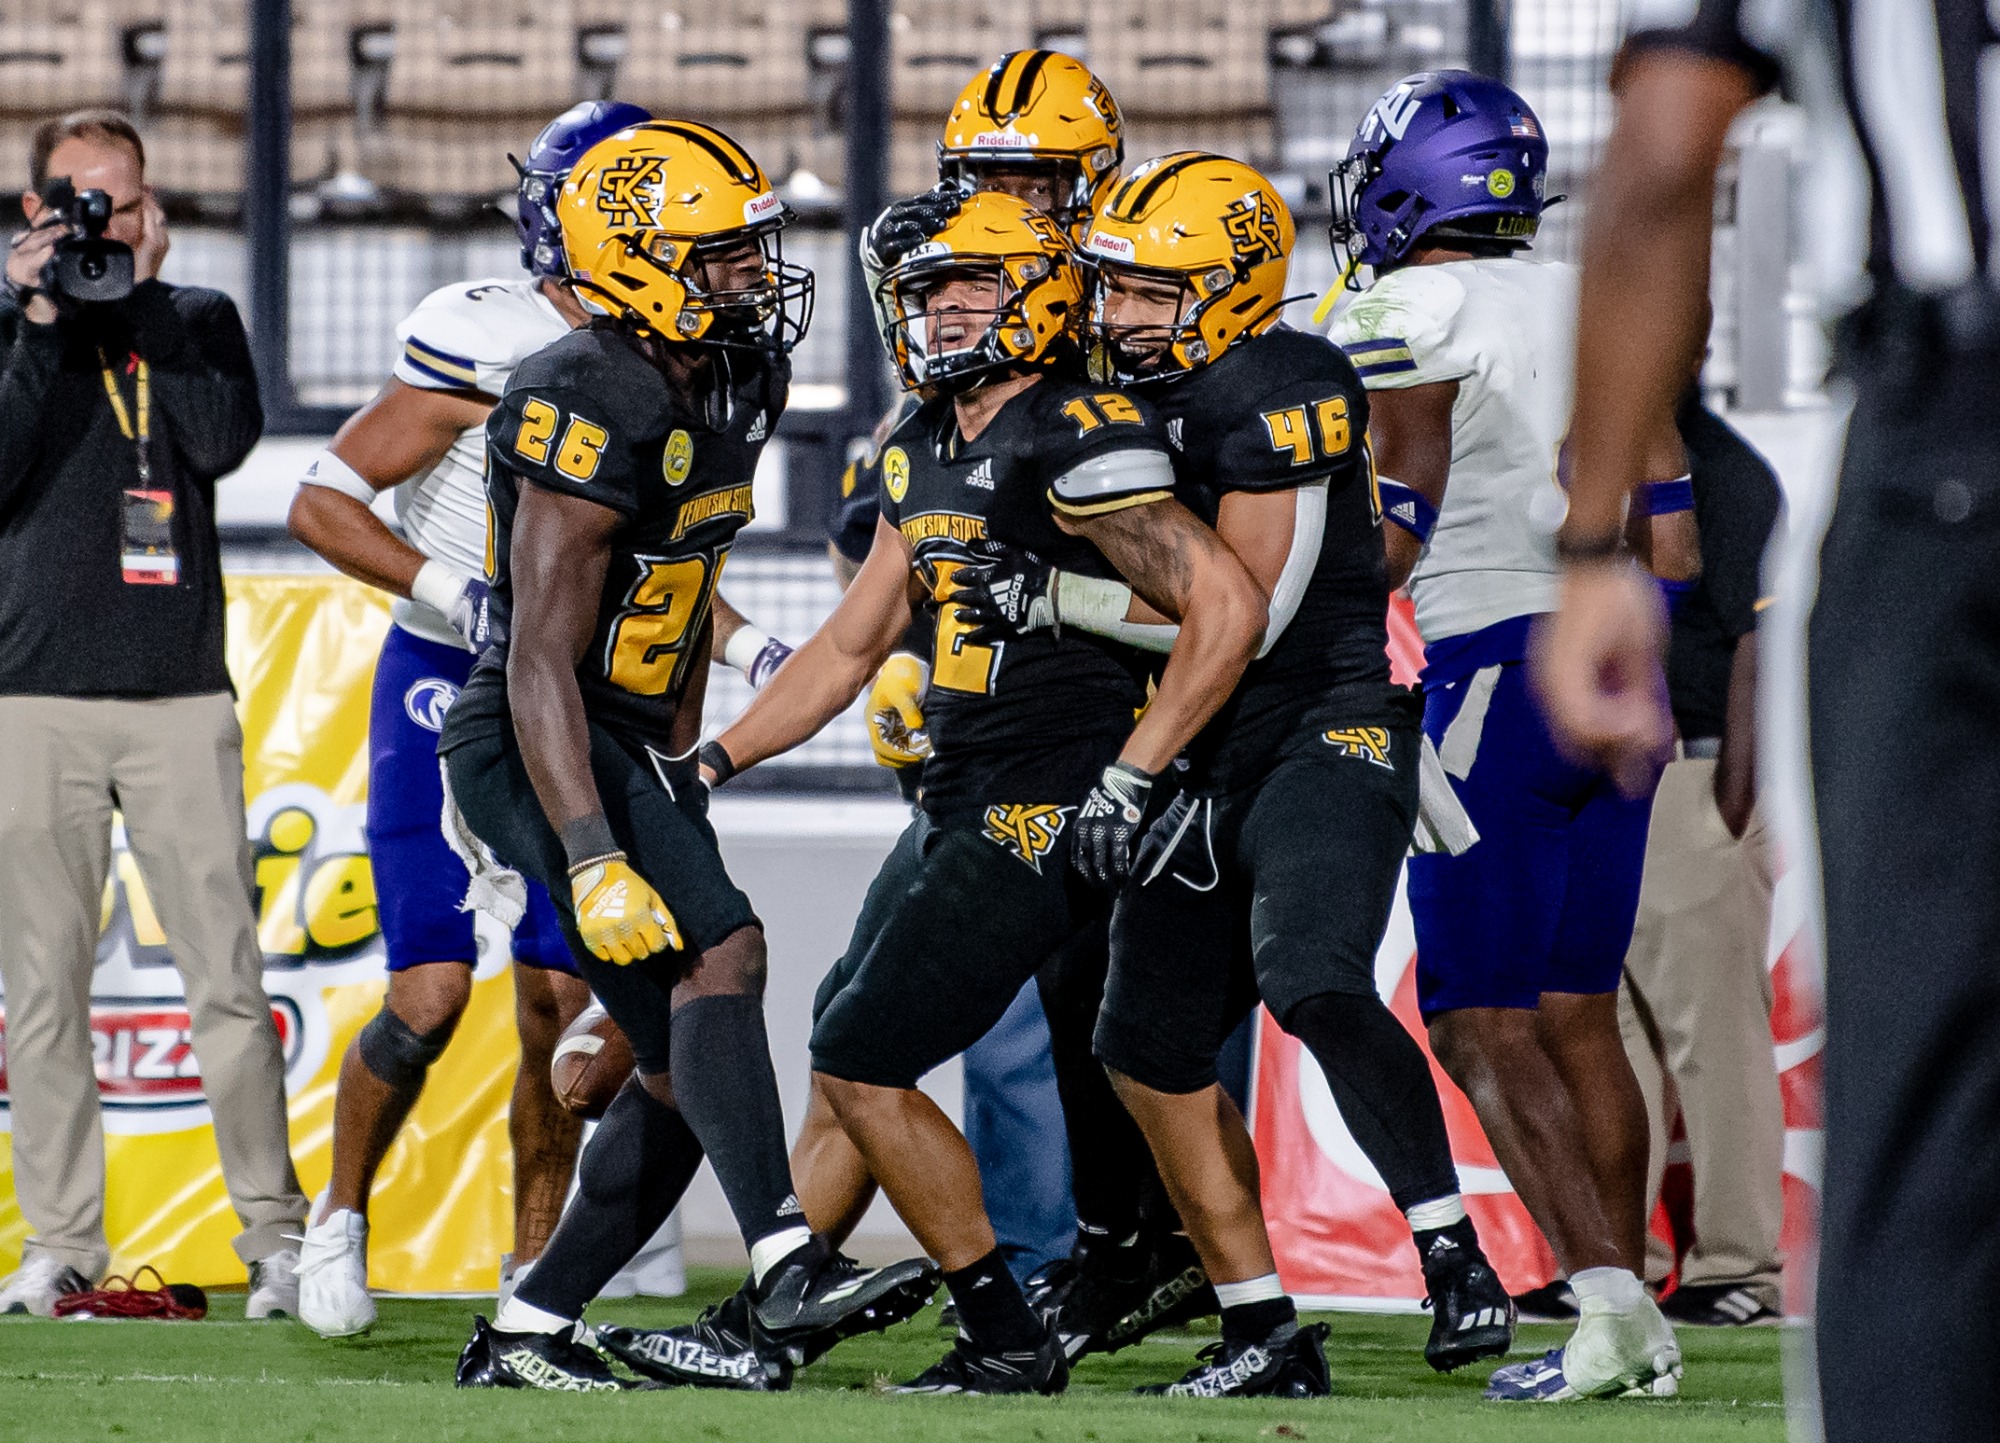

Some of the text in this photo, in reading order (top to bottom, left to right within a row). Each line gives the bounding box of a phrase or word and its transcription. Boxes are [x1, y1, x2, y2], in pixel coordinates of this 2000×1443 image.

[977, 135, 1022, 146] Riddell
[1093, 233, 1128, 253] Riddell
[1060, 392, 1145, 439] 12
[1259, 394, 1351, 467] 46
[515, 395, 610, 483] 26
[965, 475, 995, 491] adidas
[951, 516, 987, 543] STATE
[476, 596, 489, 642] adidas
[1007, 573, 1025, 623] adidas
